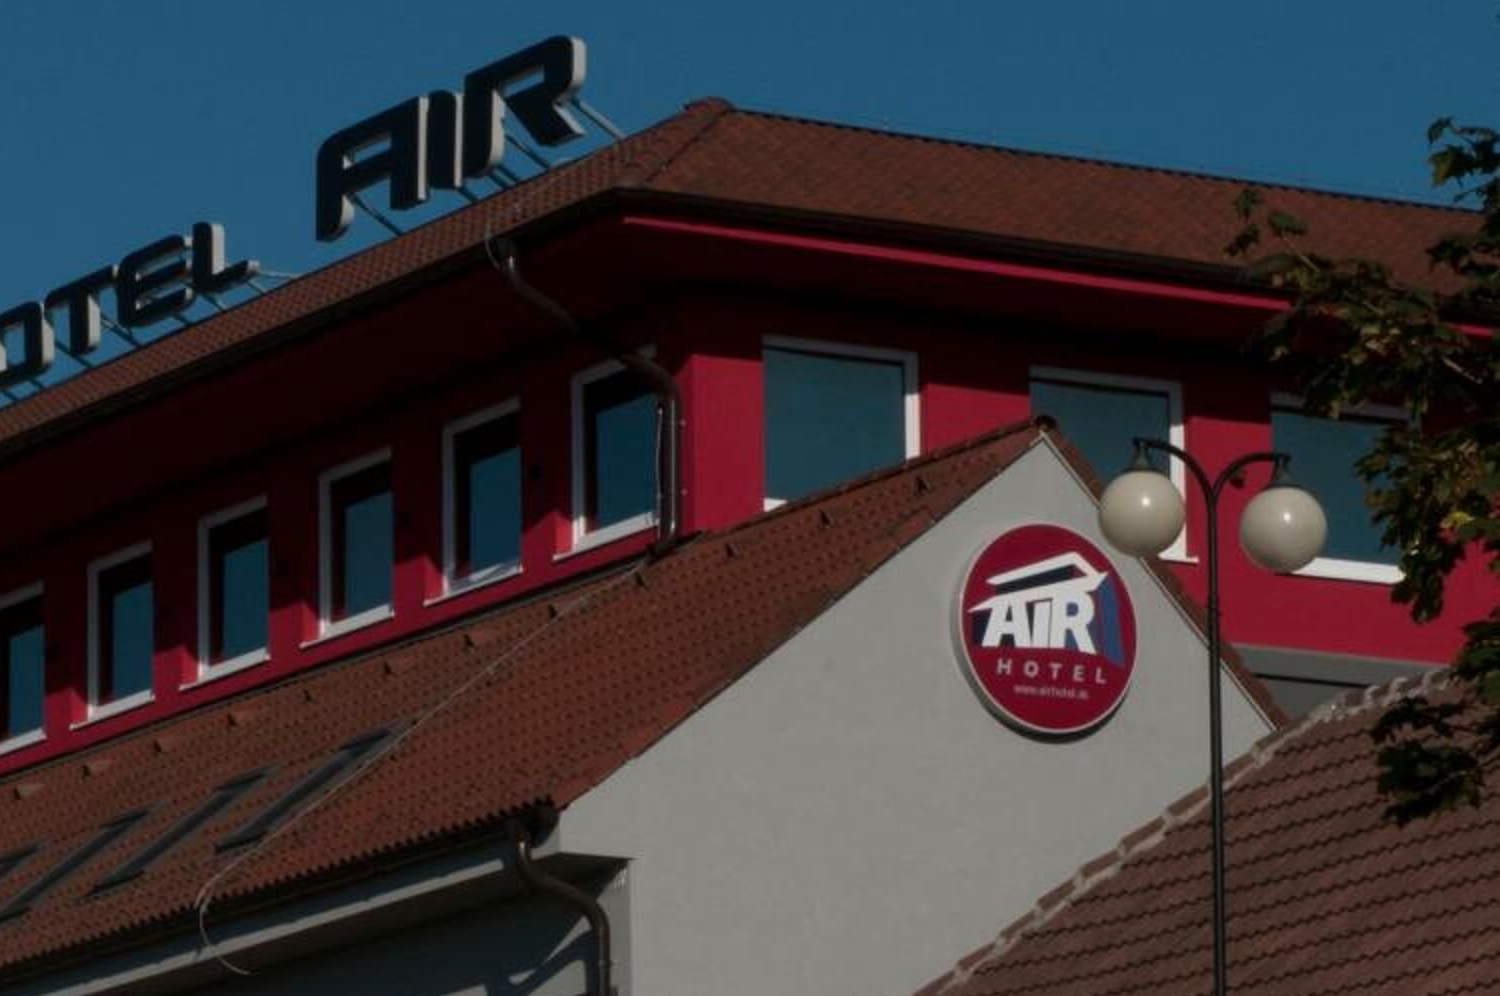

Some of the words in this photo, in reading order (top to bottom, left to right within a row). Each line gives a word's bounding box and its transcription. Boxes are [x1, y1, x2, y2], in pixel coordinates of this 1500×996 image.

[316, 35, 586, 242] AIR
[980, 588, 1097, 655] AIR
[996, 658, 1107, 685] HOTEL
